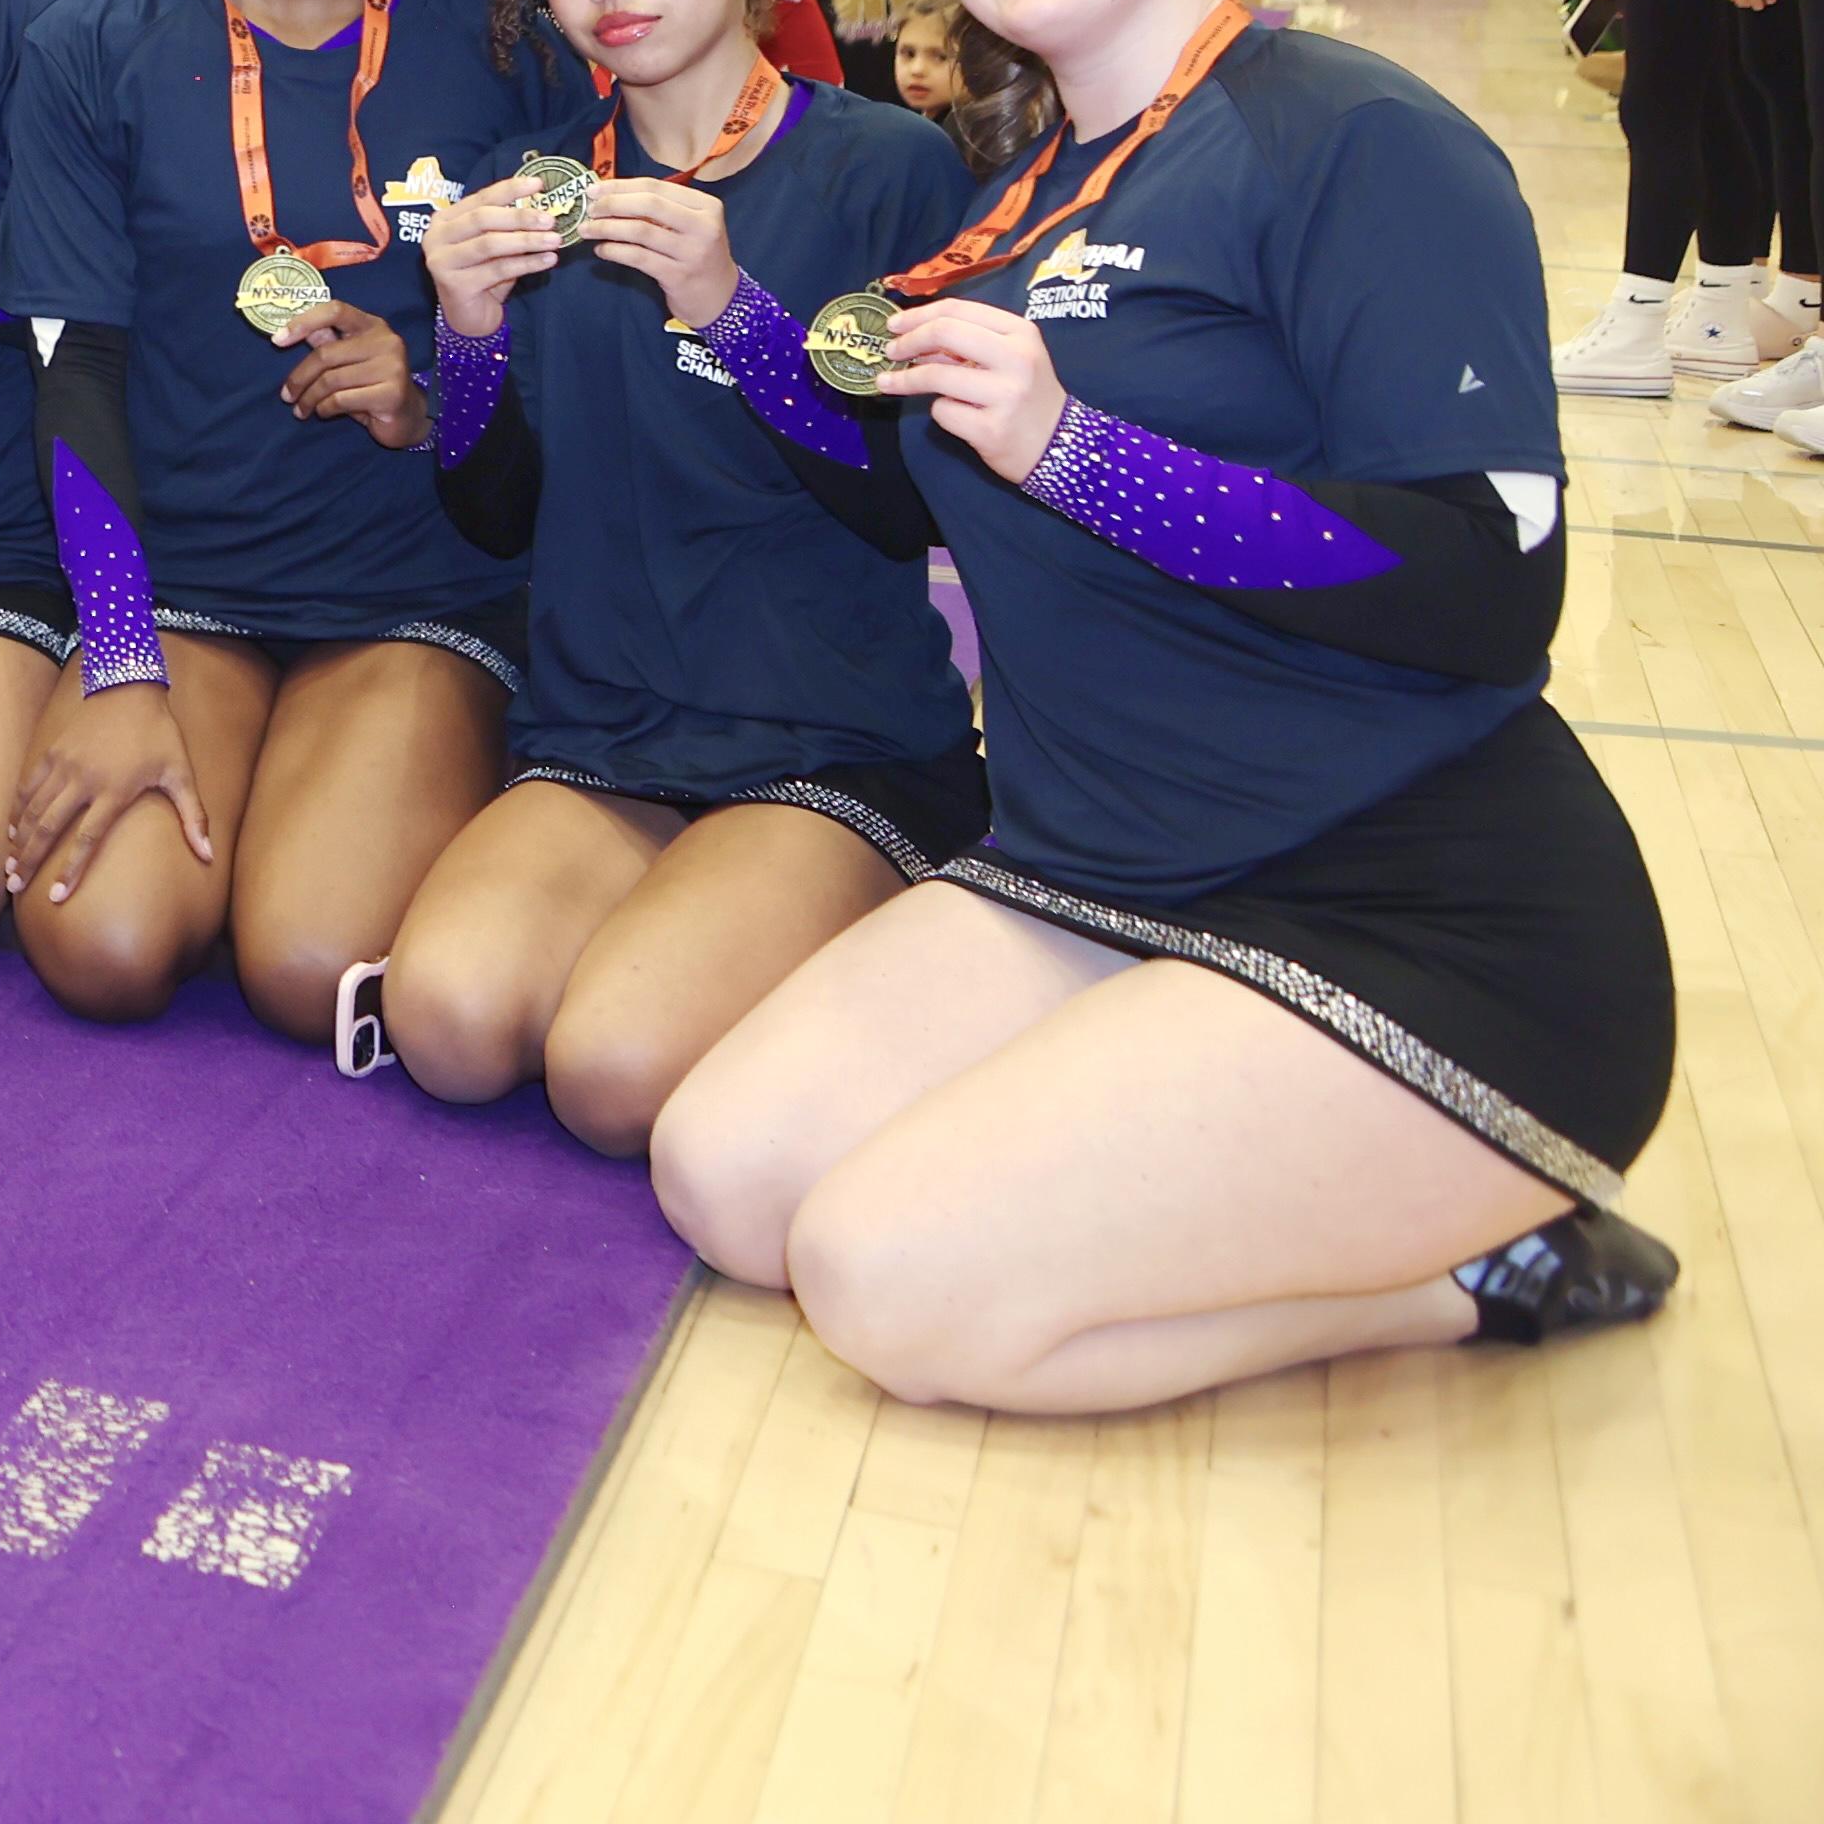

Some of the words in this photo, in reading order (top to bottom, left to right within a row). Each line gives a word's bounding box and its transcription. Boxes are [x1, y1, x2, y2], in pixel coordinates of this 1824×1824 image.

[252, 286, 330, 301] NYSPHSAA
[1027, 284, 1087, 305] SECTION
[1088, 283, 1110, 301] IX
[1024, 300, 1108, 321] CHAMPION
